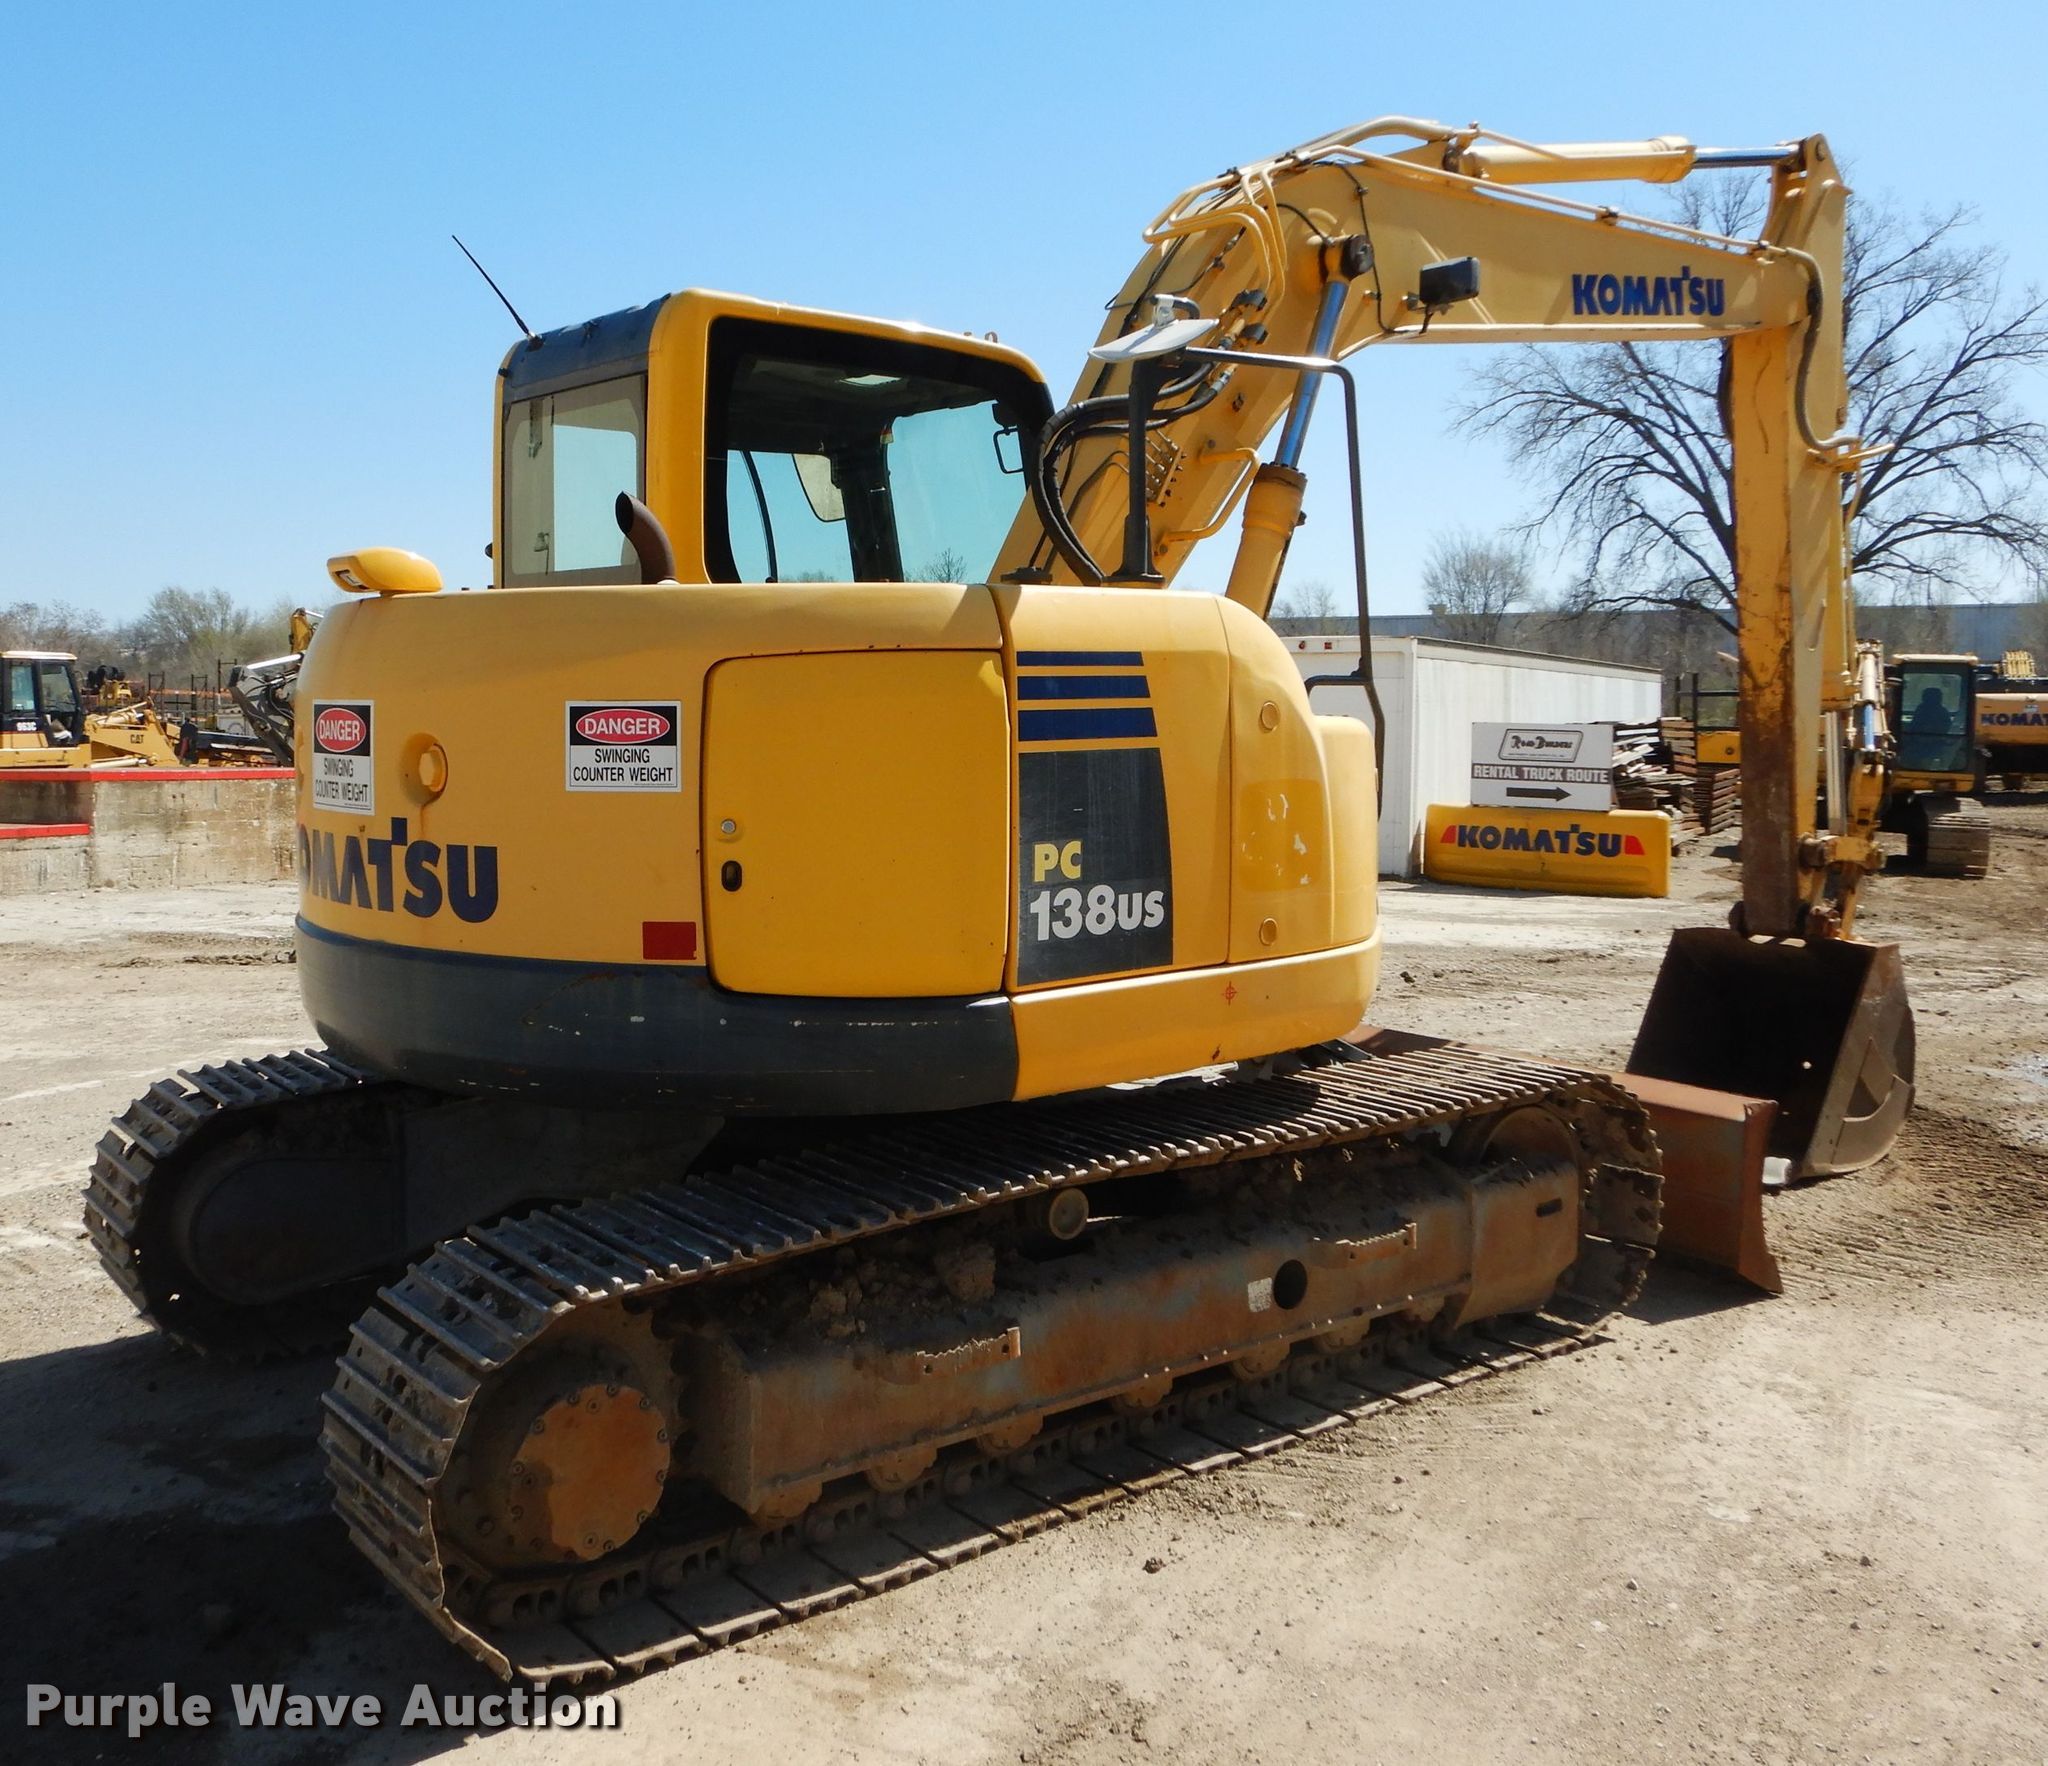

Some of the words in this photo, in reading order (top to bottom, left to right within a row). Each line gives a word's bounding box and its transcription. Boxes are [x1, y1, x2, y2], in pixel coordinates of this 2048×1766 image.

[1572, 265, 1725, 317] KOMATSU
[319, 718, 361, 741] DANGER
[584, 718, 661, 735] DANGER
[130, 734, 144, 745] CAT
[594, 748, 650, 764] SWINGING
[323, 757, 354, 778] SWINGING
[573, 766, 625, 782] COUNTER
[629, 766, 673, 782] WEIGHT
[1473, 764, 1520, 780] RENTAL
[1522, 766, 1563, 781] TRUCK
[1566, 769, 1609, 783] ROUTE
[315, 779, 340, 800] COUNTER
[341, 782, 369, 802] WEIGHT
[1457, 824, 1622, 858] KOMATSU
[1033, 840, 1082, 883] PC
